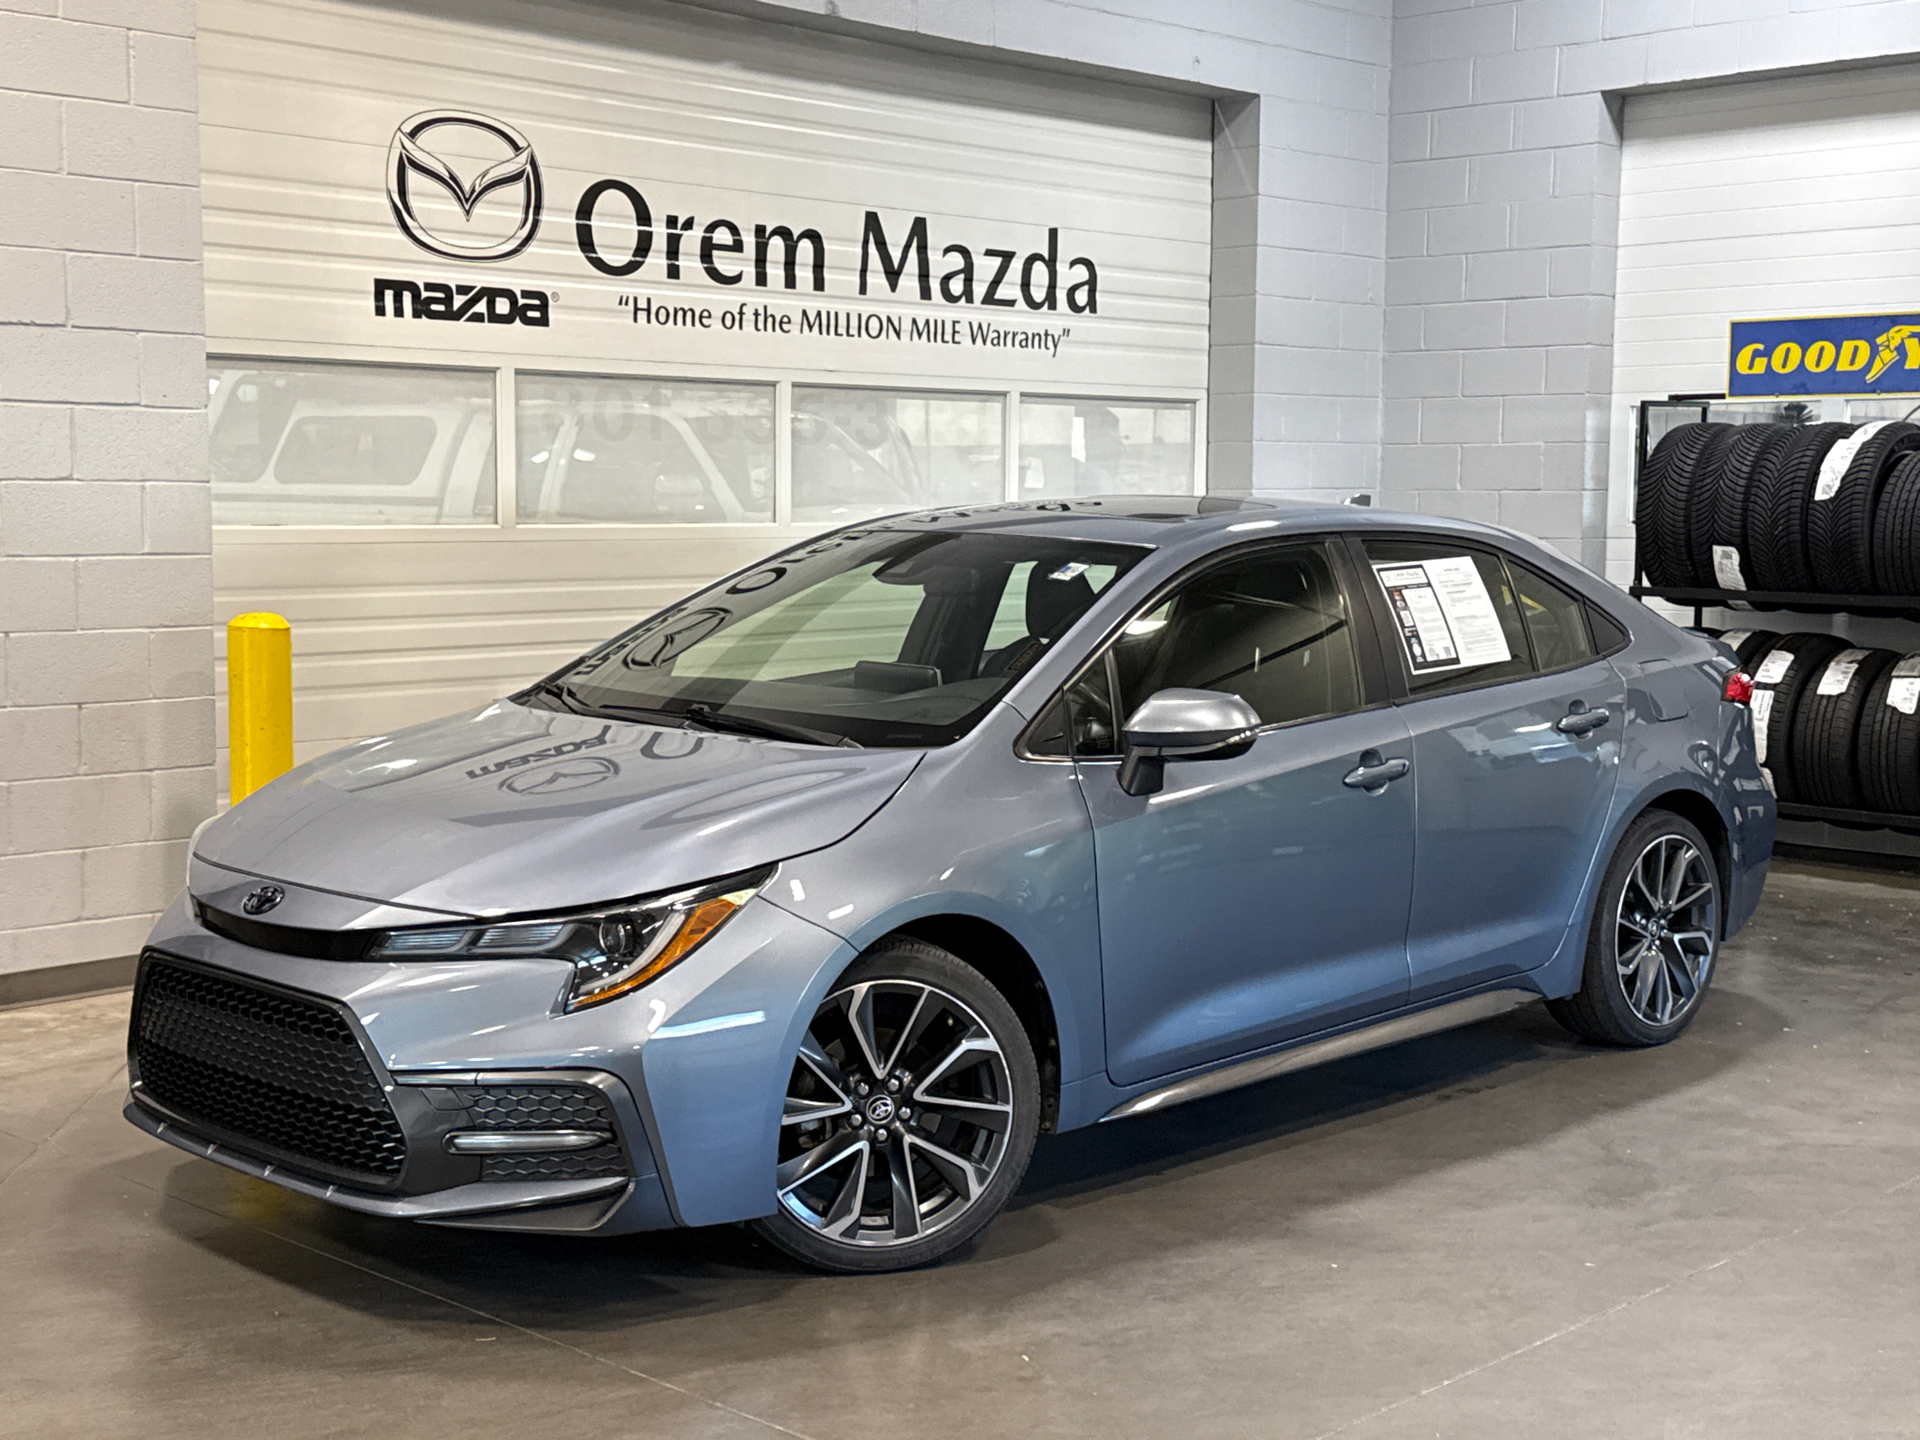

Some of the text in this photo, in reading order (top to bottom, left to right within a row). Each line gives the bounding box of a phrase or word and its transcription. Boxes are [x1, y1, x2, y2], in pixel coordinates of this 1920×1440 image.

[574, 179, 1098, 314] Orem Mazda
[721, 303, 747, 331] of
[753, 304, 792, 334] the
[800, 309, 902, 341] MILLION
[910, 317, 962, 345] MILE
